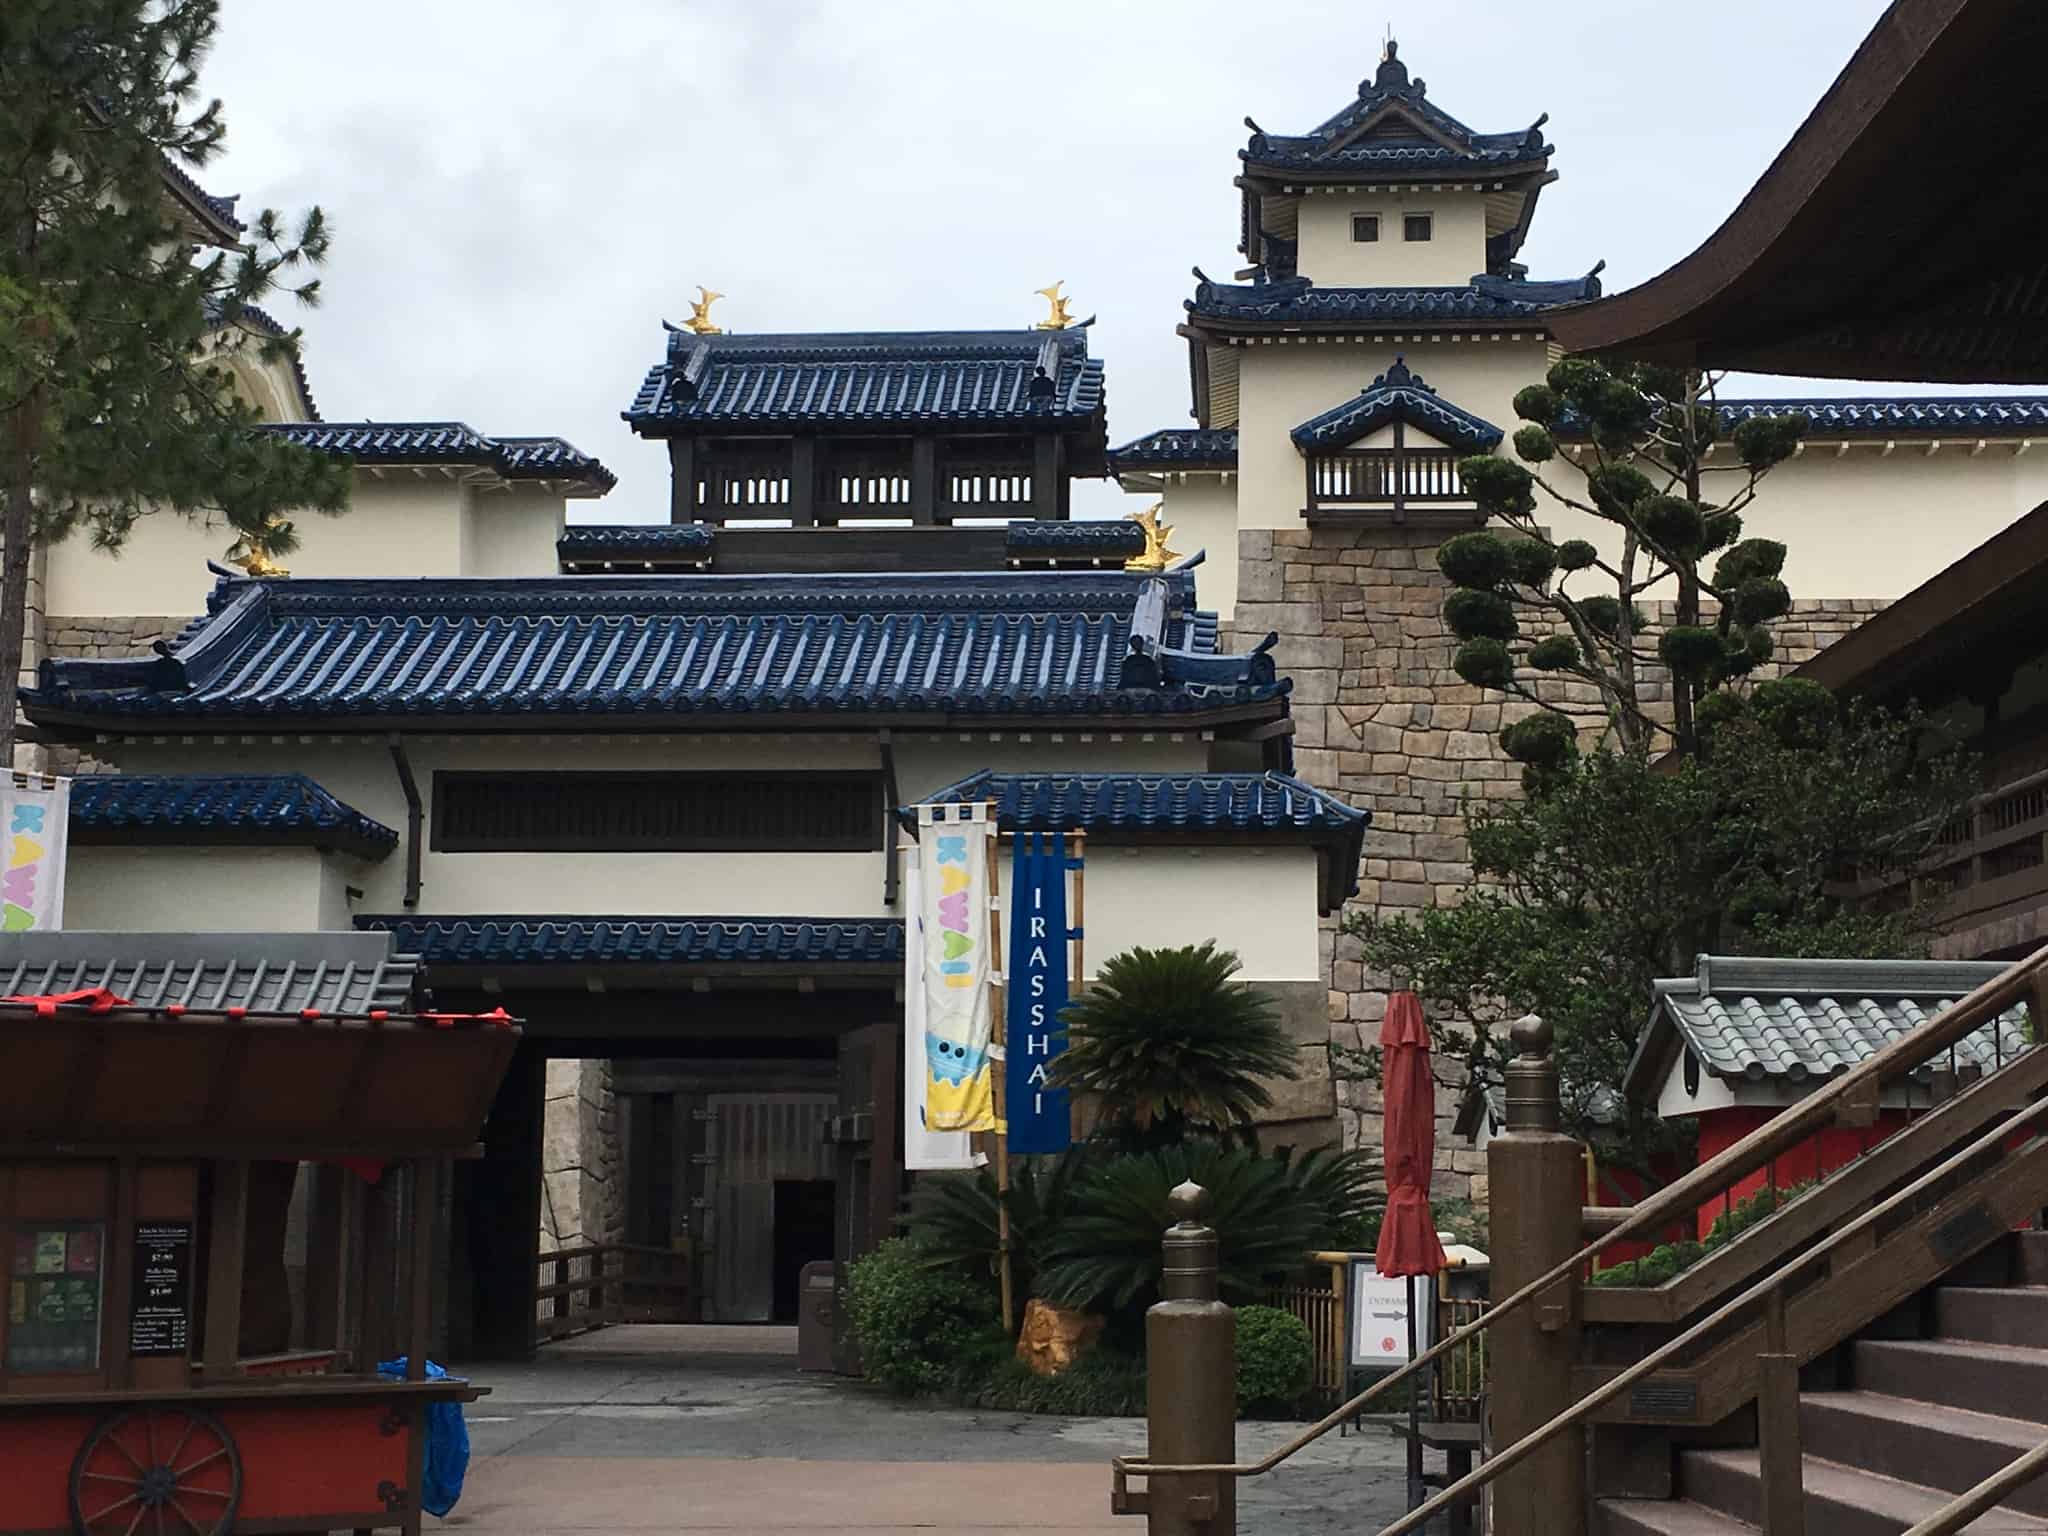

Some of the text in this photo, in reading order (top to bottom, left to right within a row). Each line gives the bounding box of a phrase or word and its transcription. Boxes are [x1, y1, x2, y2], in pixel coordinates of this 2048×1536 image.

[3, 805, 46, 931] KAWA
[936, 836, 975, 988] KAWAII
[1027, 887, 1048, 1114] IRASSHAI
